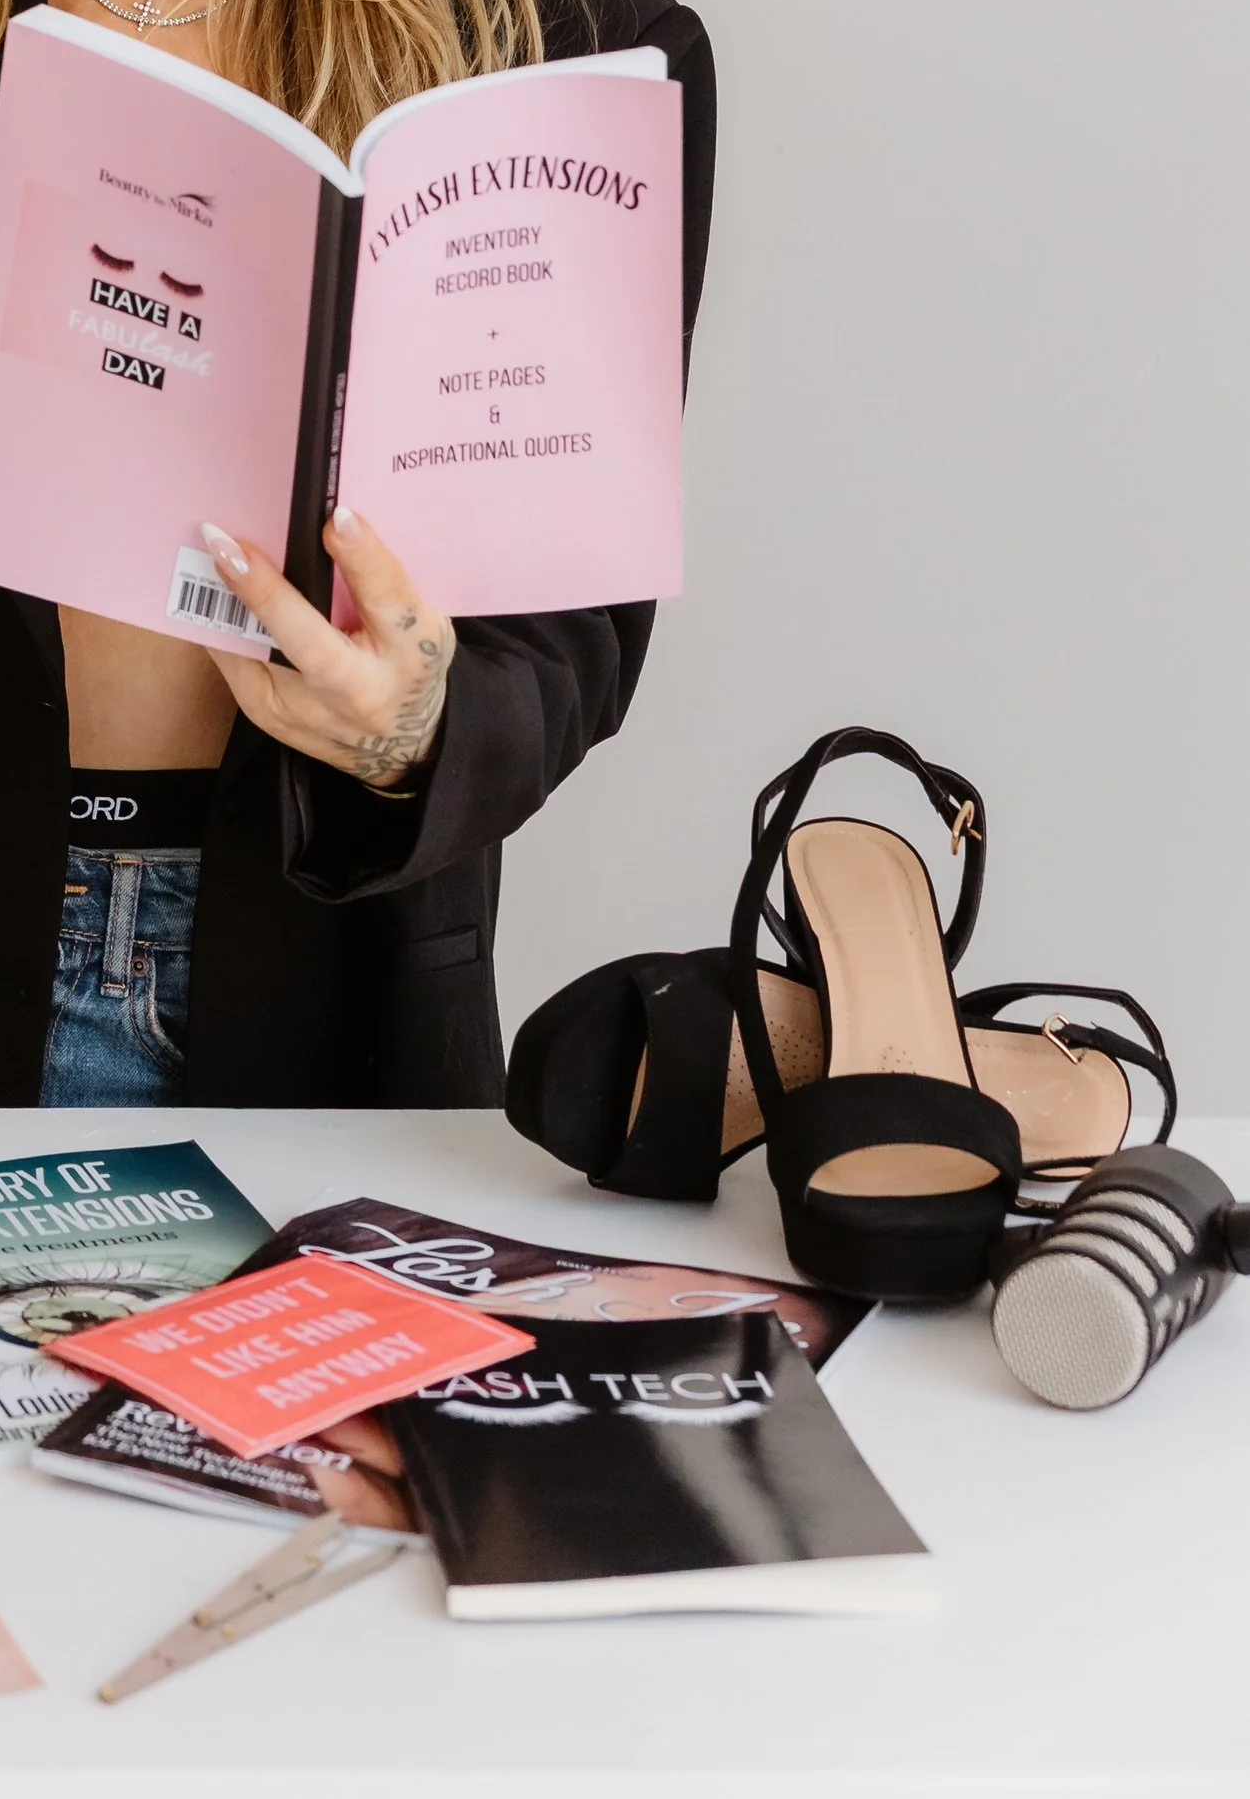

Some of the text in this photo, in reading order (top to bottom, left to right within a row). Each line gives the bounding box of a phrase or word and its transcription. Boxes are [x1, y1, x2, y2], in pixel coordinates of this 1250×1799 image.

[99, 168, 151, 201] Beauty
[369, 154, 648, 263] EYELASH EXTENSIONS
[445, 225, 542, 259] INVENTORY
[435, 259, 554, 296] RECORD BOOK
[93, 280, 200, 339] HAVE A
[104, 350, 163, 387] DAY
[439, 364, 546, 395] NOTE PAGES
[489, 404, 501, 424] &
[392, 432, 592, 473] INSPIRATIONAL QUOTES
[56, 1160, 112, 1194] OF
[21, 1228, 180, 1254] treatments
[121, 1276, 330, 1356] WE DIDN'T
[190, 1307, 378, 1380] LIKE HIM
[255, 1331, 427, 1410] ANYWAY
[590, 1369, 775, 1402] TECH
